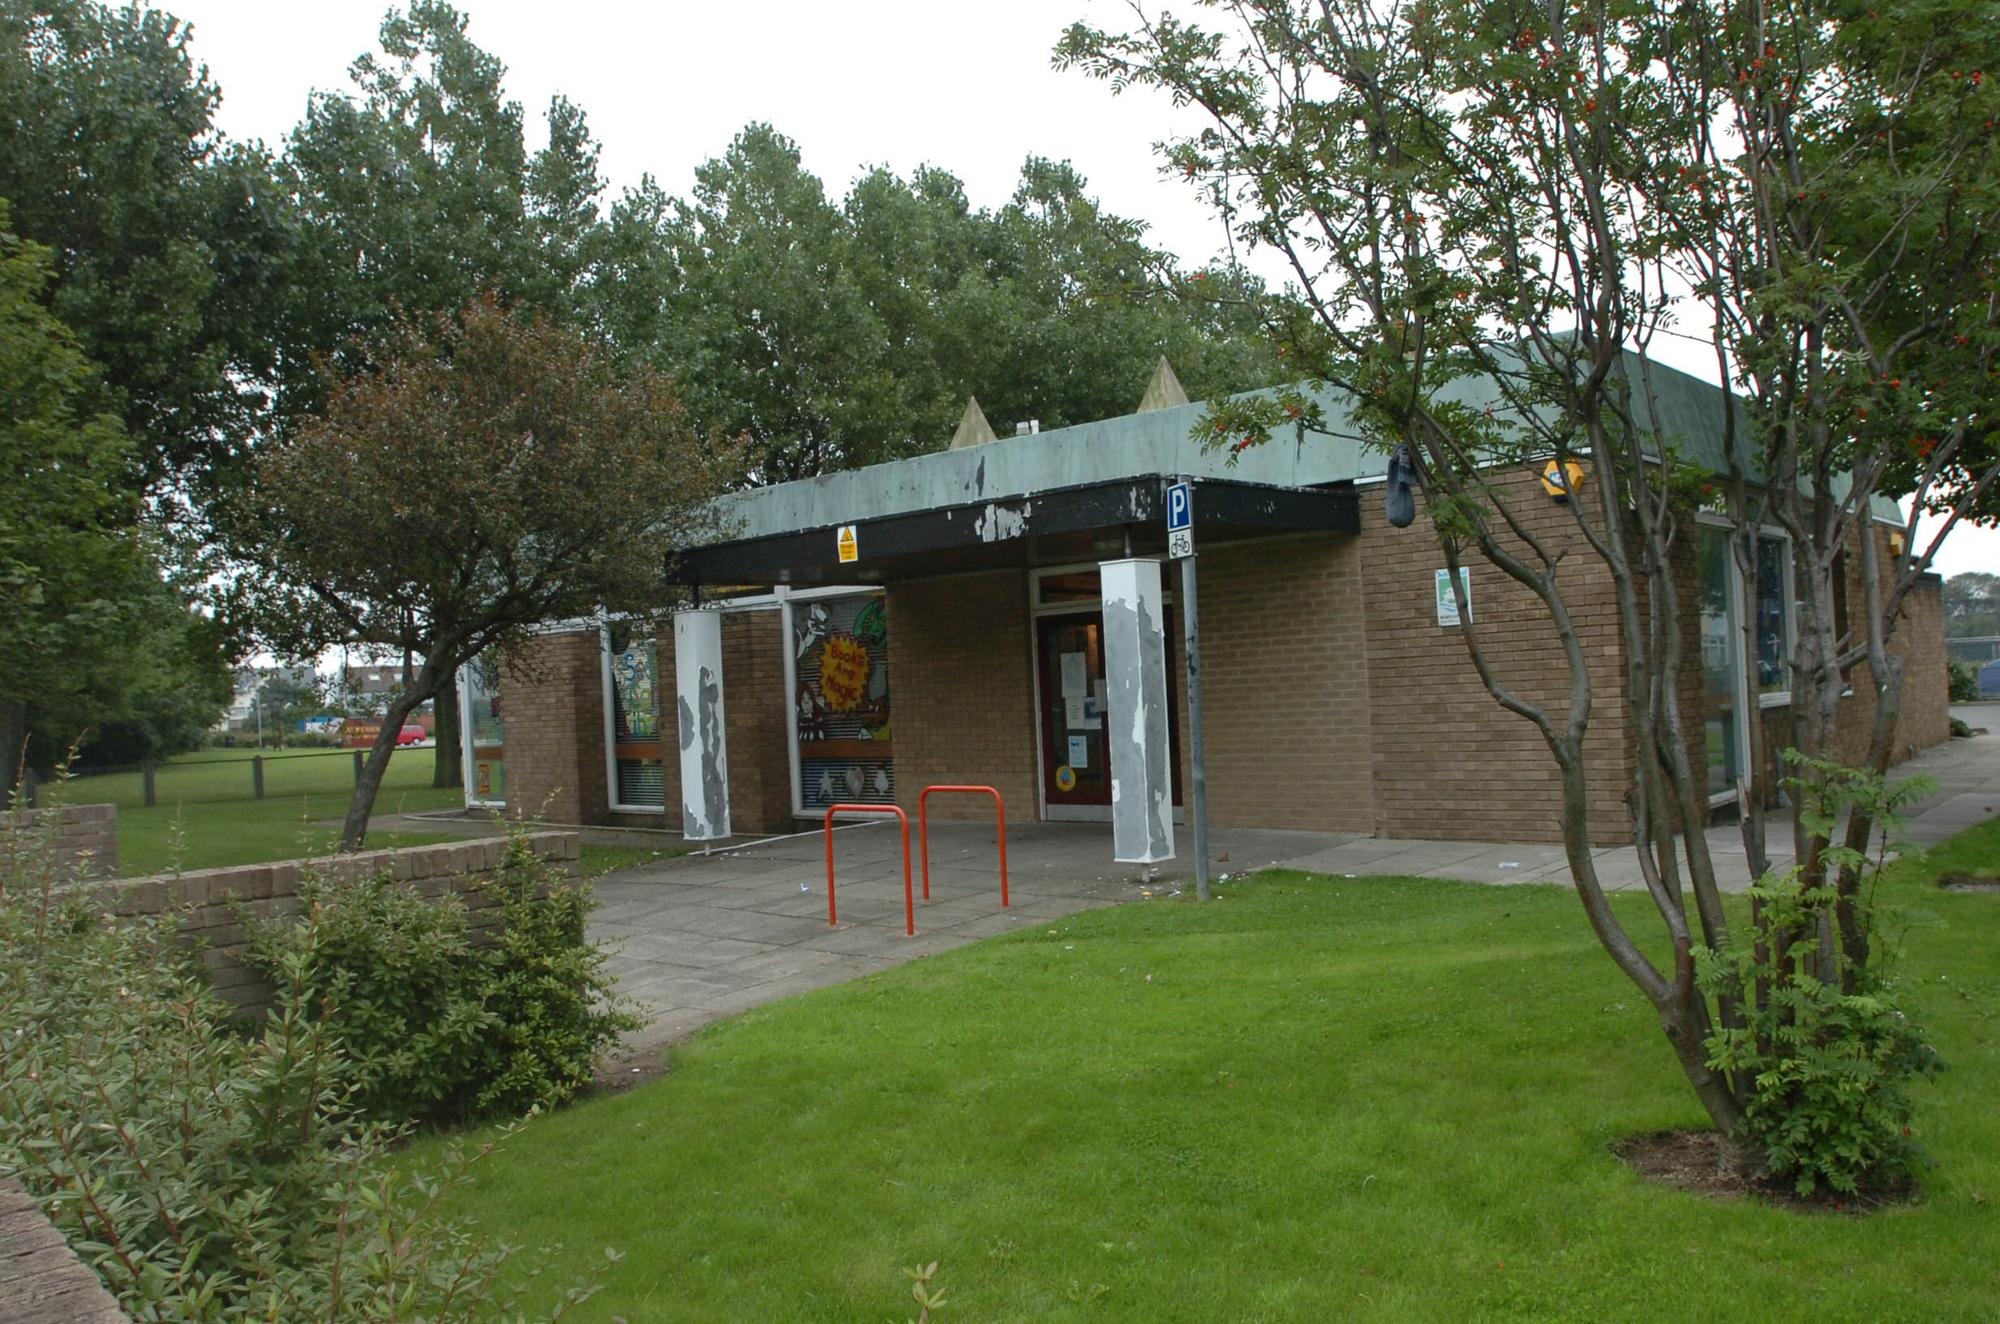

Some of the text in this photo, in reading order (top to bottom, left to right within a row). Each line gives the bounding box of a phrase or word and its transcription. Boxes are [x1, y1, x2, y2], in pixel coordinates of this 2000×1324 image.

[1173, 489, 1185, 526] P
[831, 643, 865, 666] Books
[825, 674, 858, 704] Magic
